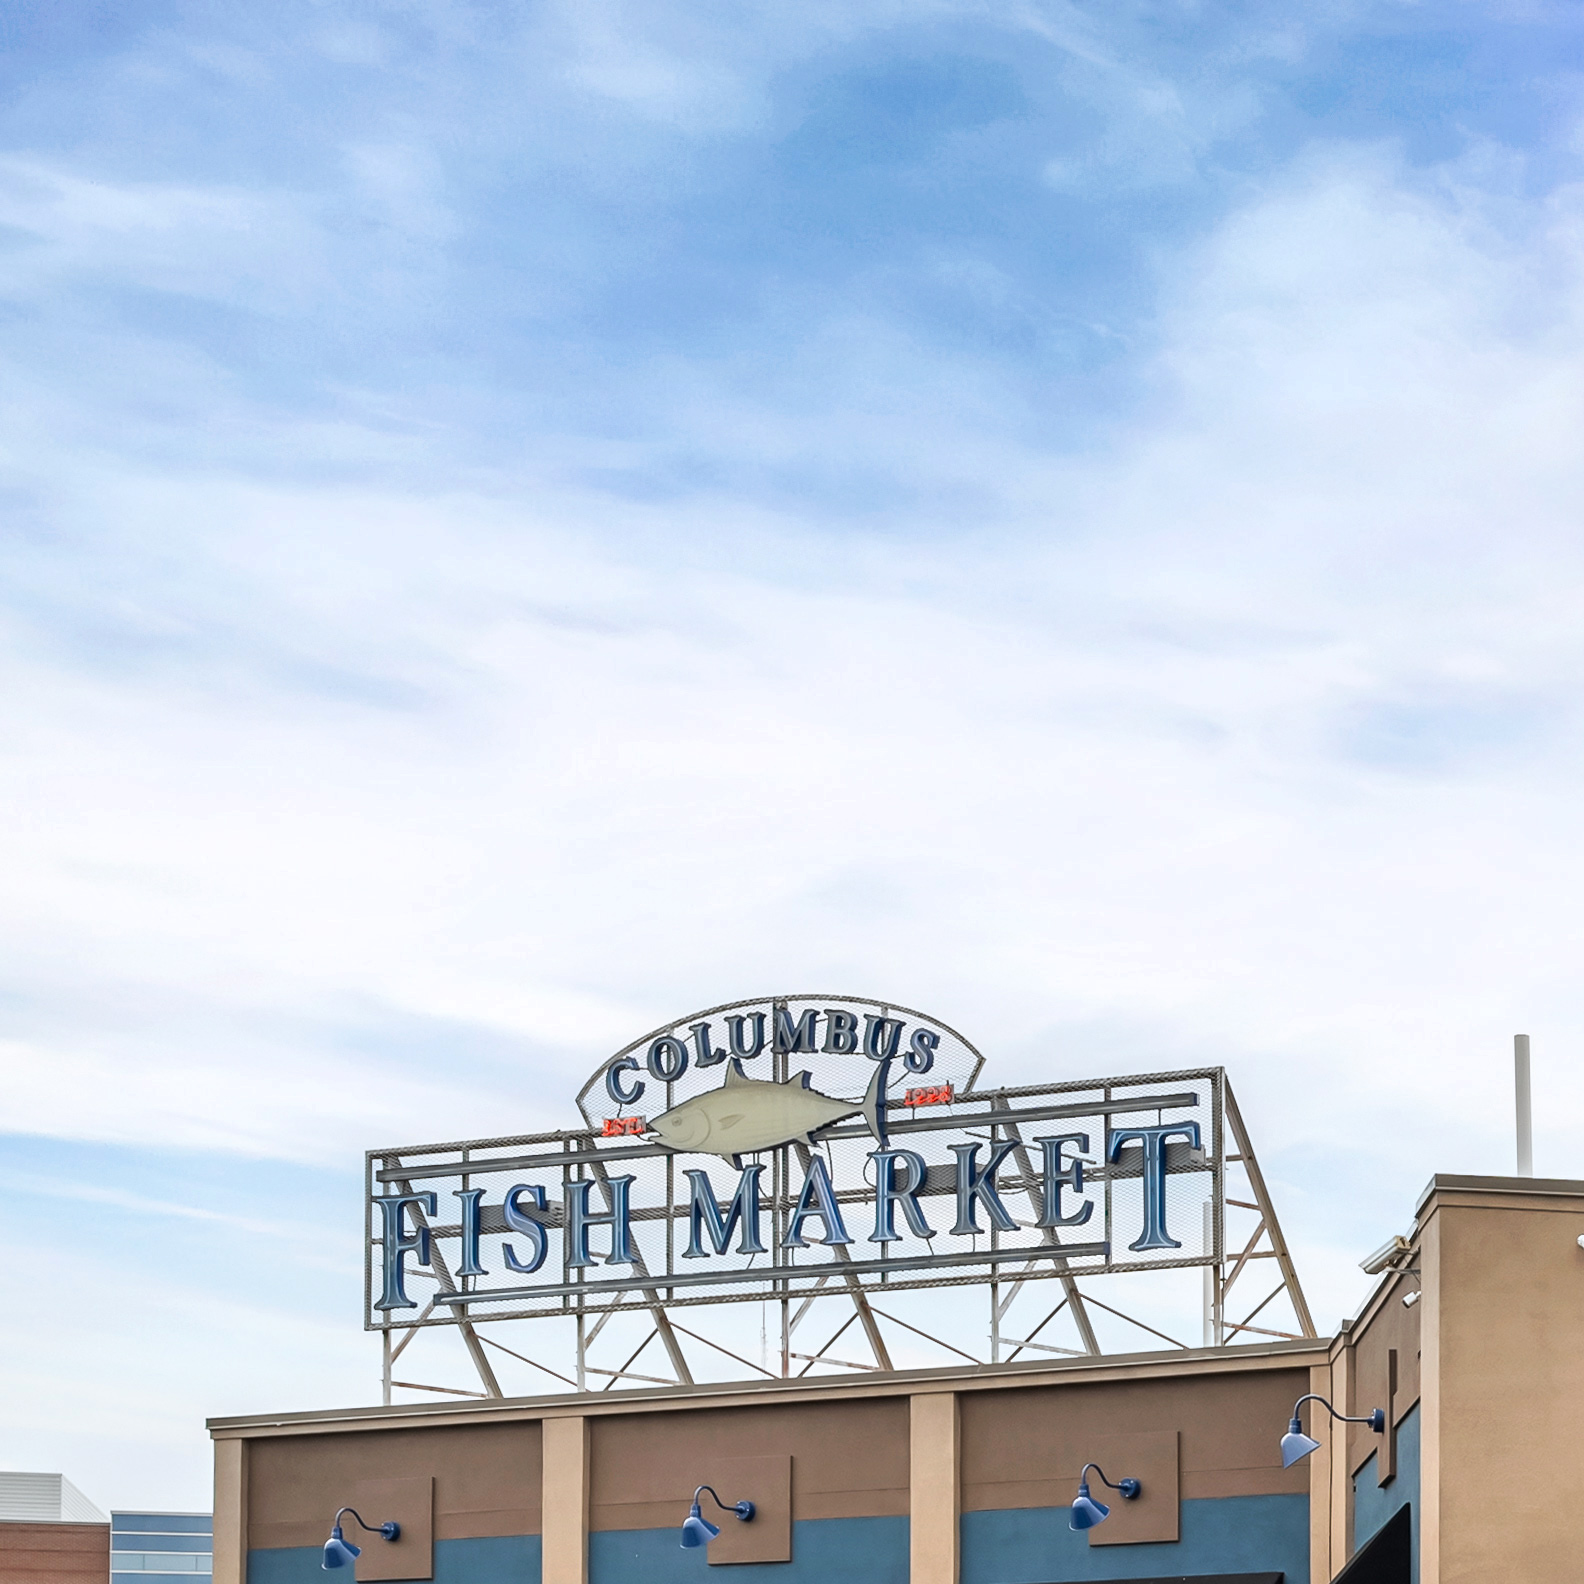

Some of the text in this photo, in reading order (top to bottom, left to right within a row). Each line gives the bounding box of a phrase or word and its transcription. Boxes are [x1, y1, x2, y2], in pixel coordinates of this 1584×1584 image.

[606, 1009, 940, 1104] COLUMBUS
[374, 1120, 1201, 1310] FISH MARKET
